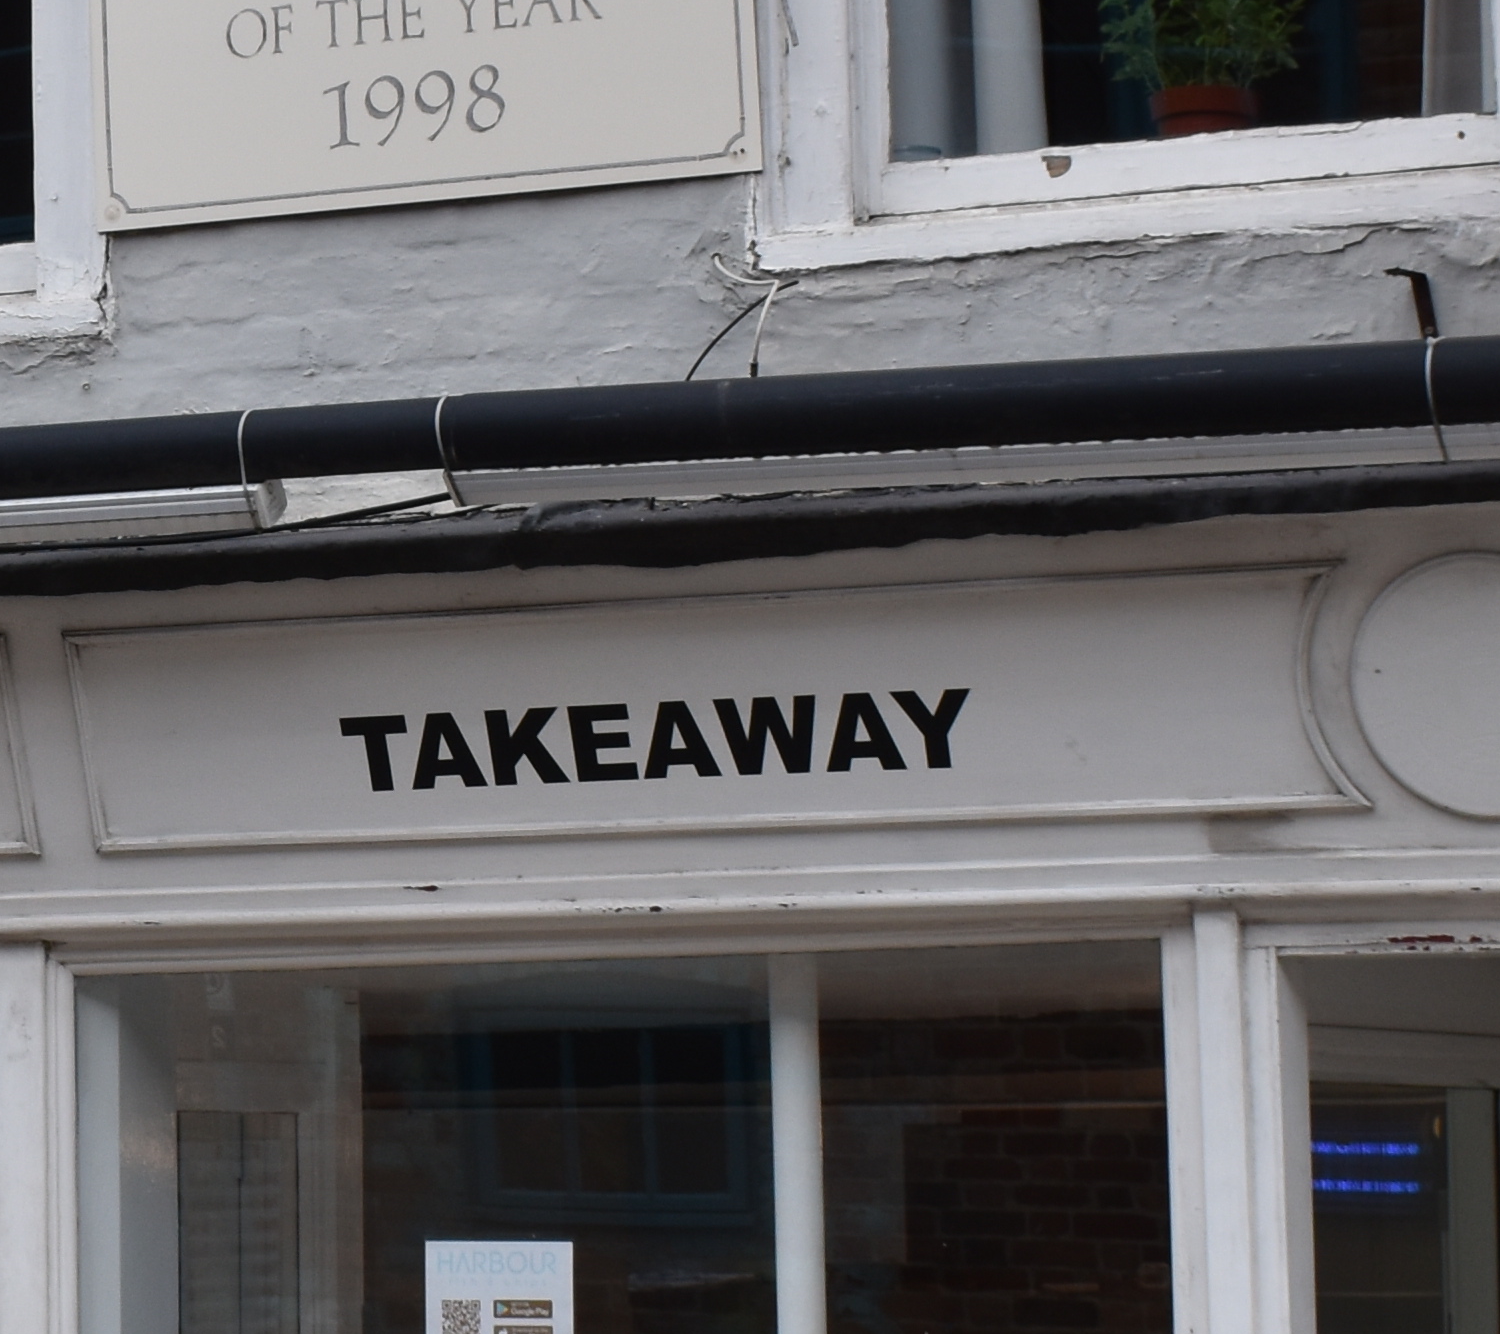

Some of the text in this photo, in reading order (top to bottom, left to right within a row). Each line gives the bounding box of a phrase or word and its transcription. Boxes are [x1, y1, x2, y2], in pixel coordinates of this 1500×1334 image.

[225, 5, 293, 59] OF
[324, 65, 506, 150] 1998
[339, 687, 972, 792] TAKEAWAY
[437, 1251, 556, 1275] HARBOUR
